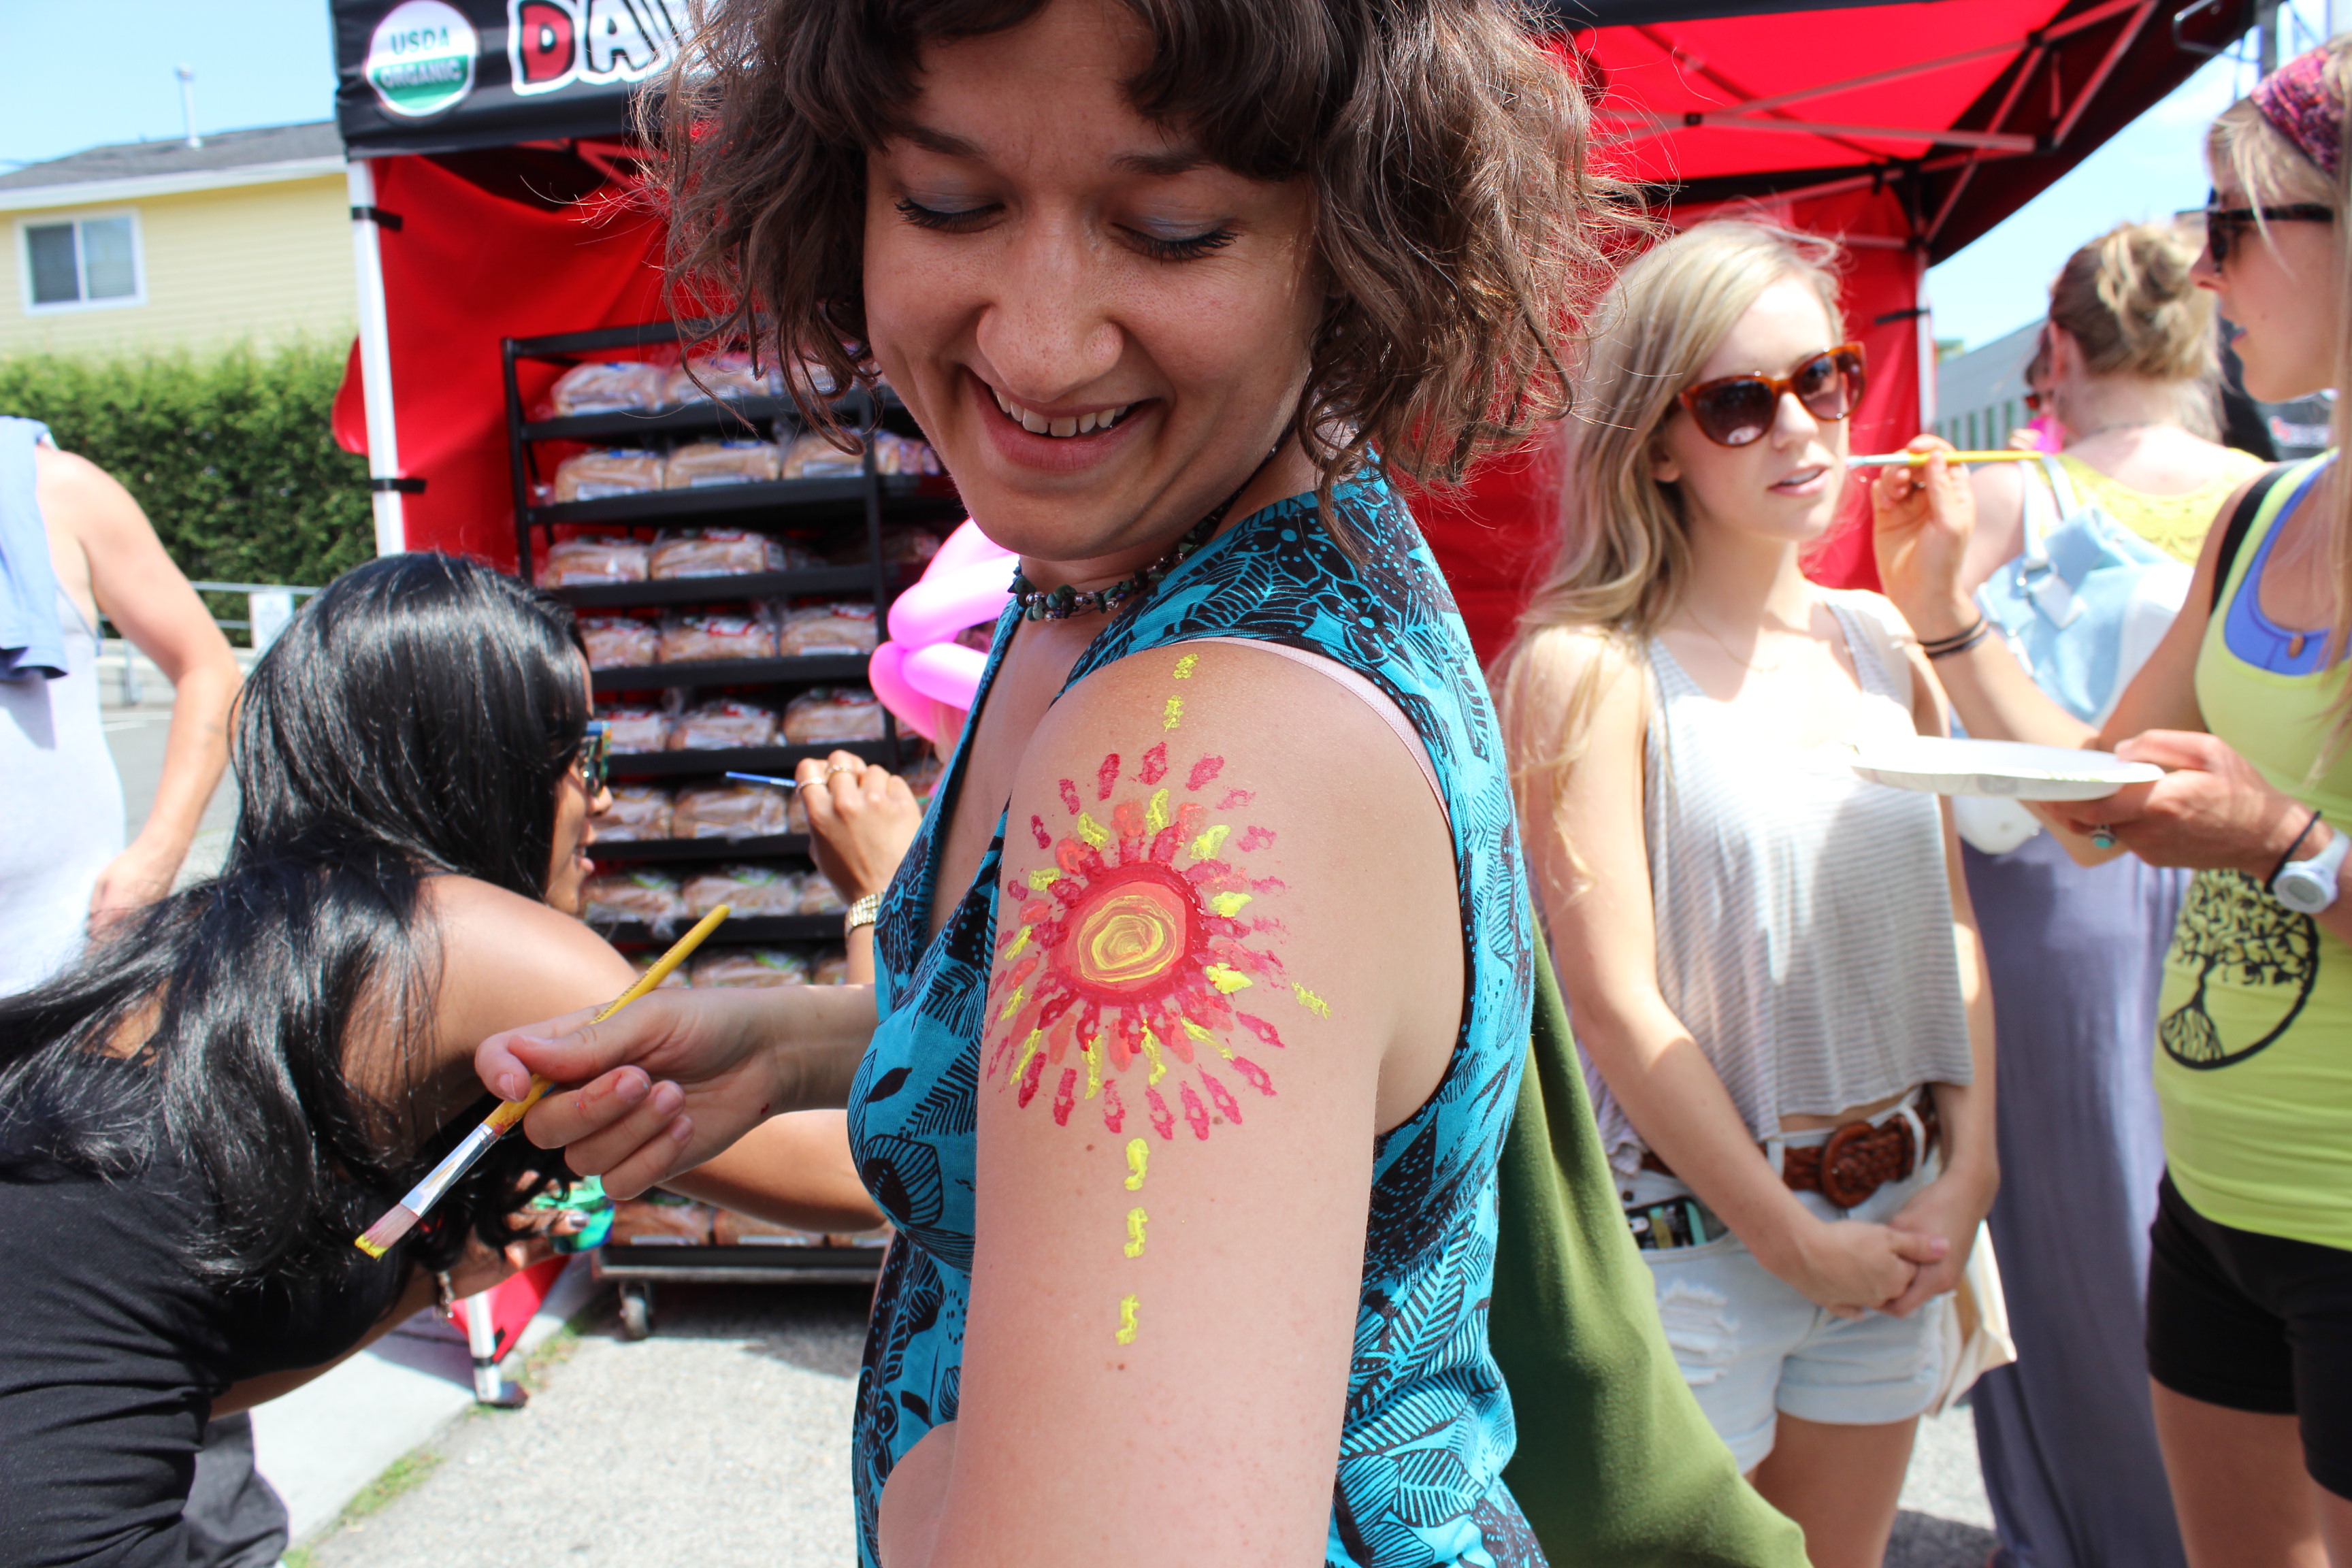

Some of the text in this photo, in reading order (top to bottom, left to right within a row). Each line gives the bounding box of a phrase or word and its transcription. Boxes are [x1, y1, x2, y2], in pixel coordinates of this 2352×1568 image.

[391, 25, 450, 55] USDA
[380, 59, 462, 89] ORGANIC
[594, 998, 619, 1023] Newton
[621, 972, 648, 998] YELLOW
